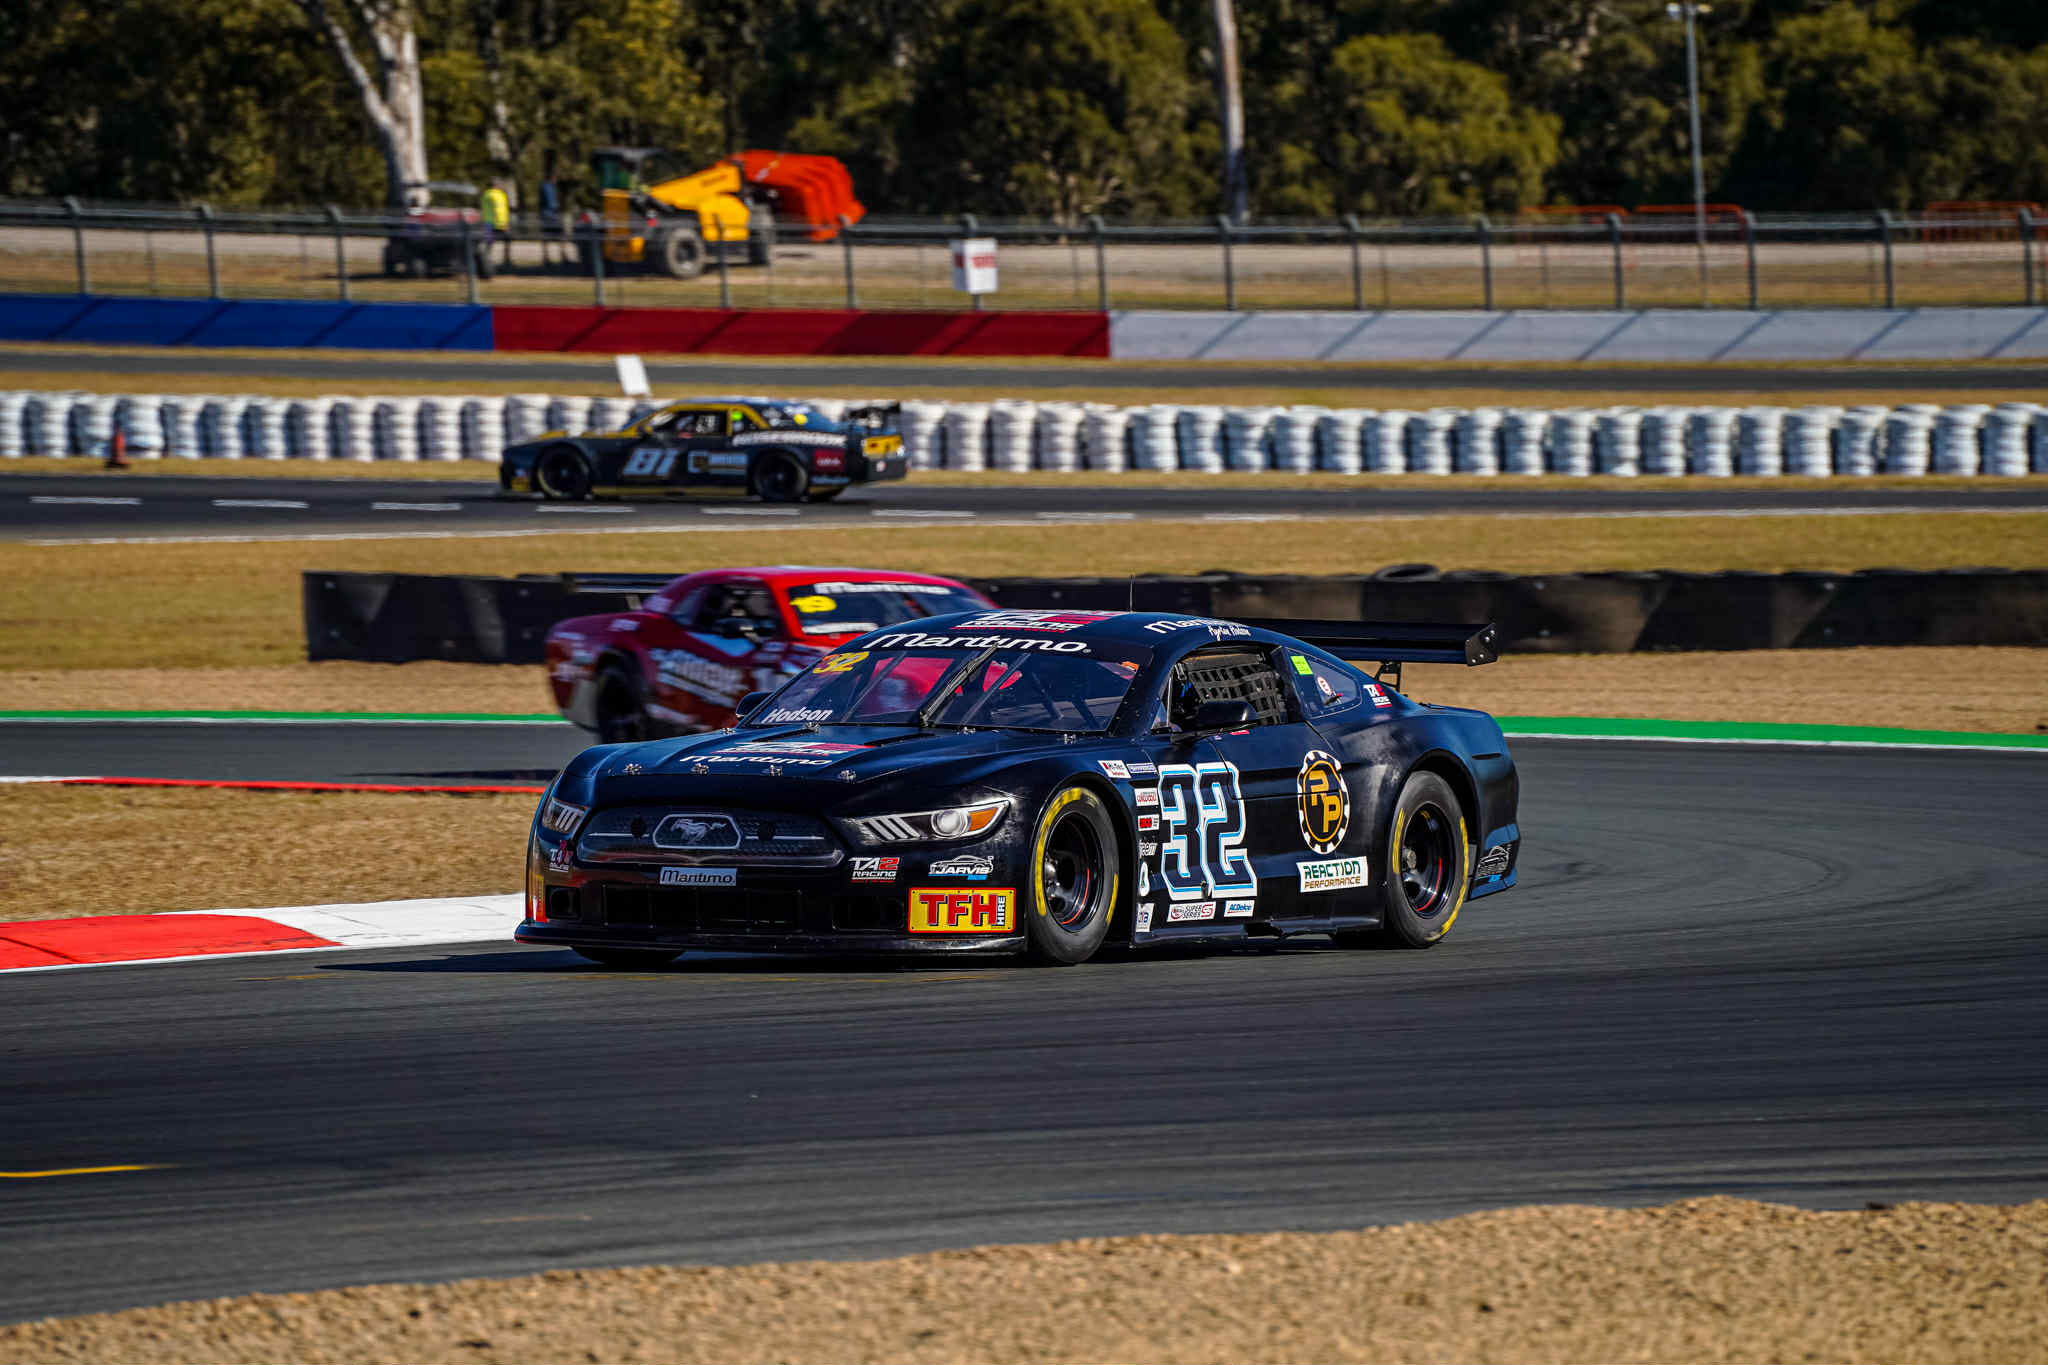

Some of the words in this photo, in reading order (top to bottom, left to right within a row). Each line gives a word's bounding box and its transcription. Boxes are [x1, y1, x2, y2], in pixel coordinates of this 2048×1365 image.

[623, 448, 679, 477] 81
[812, 650, 870, 674] 32
[762, 706, 833, 724] Hodson
[1158, 761, 1257, 900] 32
[848, 857, 900, 871] TA2
[1303, 860, 1361, 880] REACTION
[1304, 875, 1361, 889] PERFORMANCE
[919, 893, 998, 927] TFH
[996, 895, 1006, 926] HIRE
[1229, 903, 1253, 912] ACDelco
